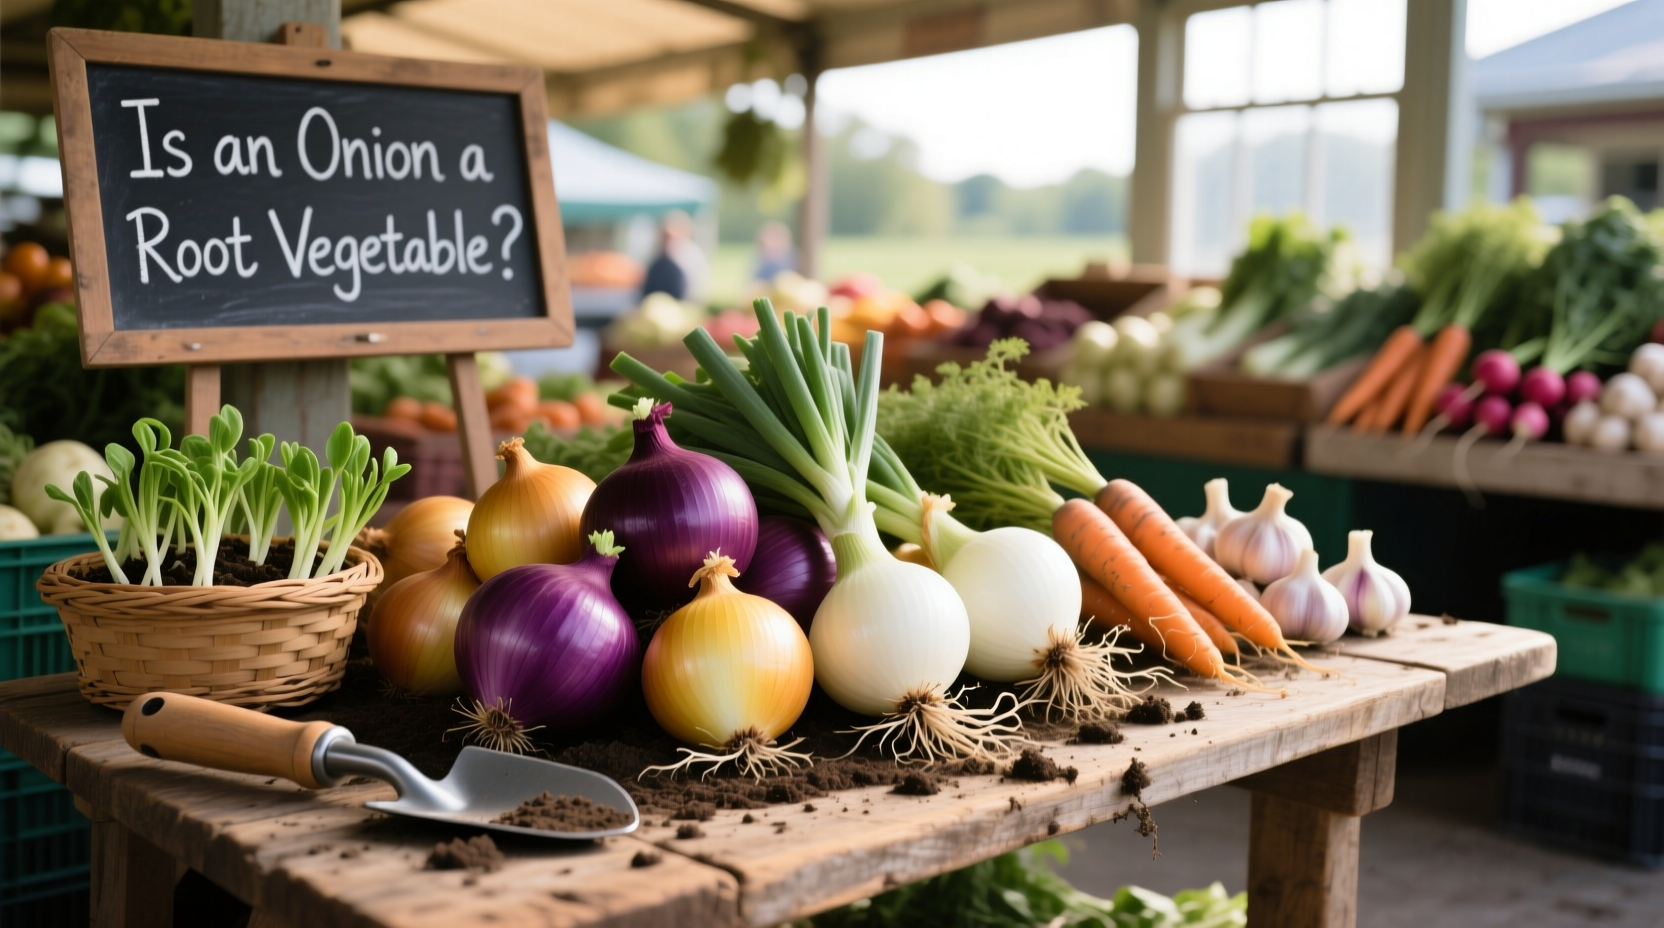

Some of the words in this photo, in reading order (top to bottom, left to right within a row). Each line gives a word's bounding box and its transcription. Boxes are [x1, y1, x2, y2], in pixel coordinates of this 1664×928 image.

[120, 97, 193, 179] Is
[213, 134, 283, 178] an
[297, 106, 446, 183] Onion
[459, 144, 494, 183] a
[125, 206, 259, 285] Root
[267, 204, 523, 303] Vegetable?
